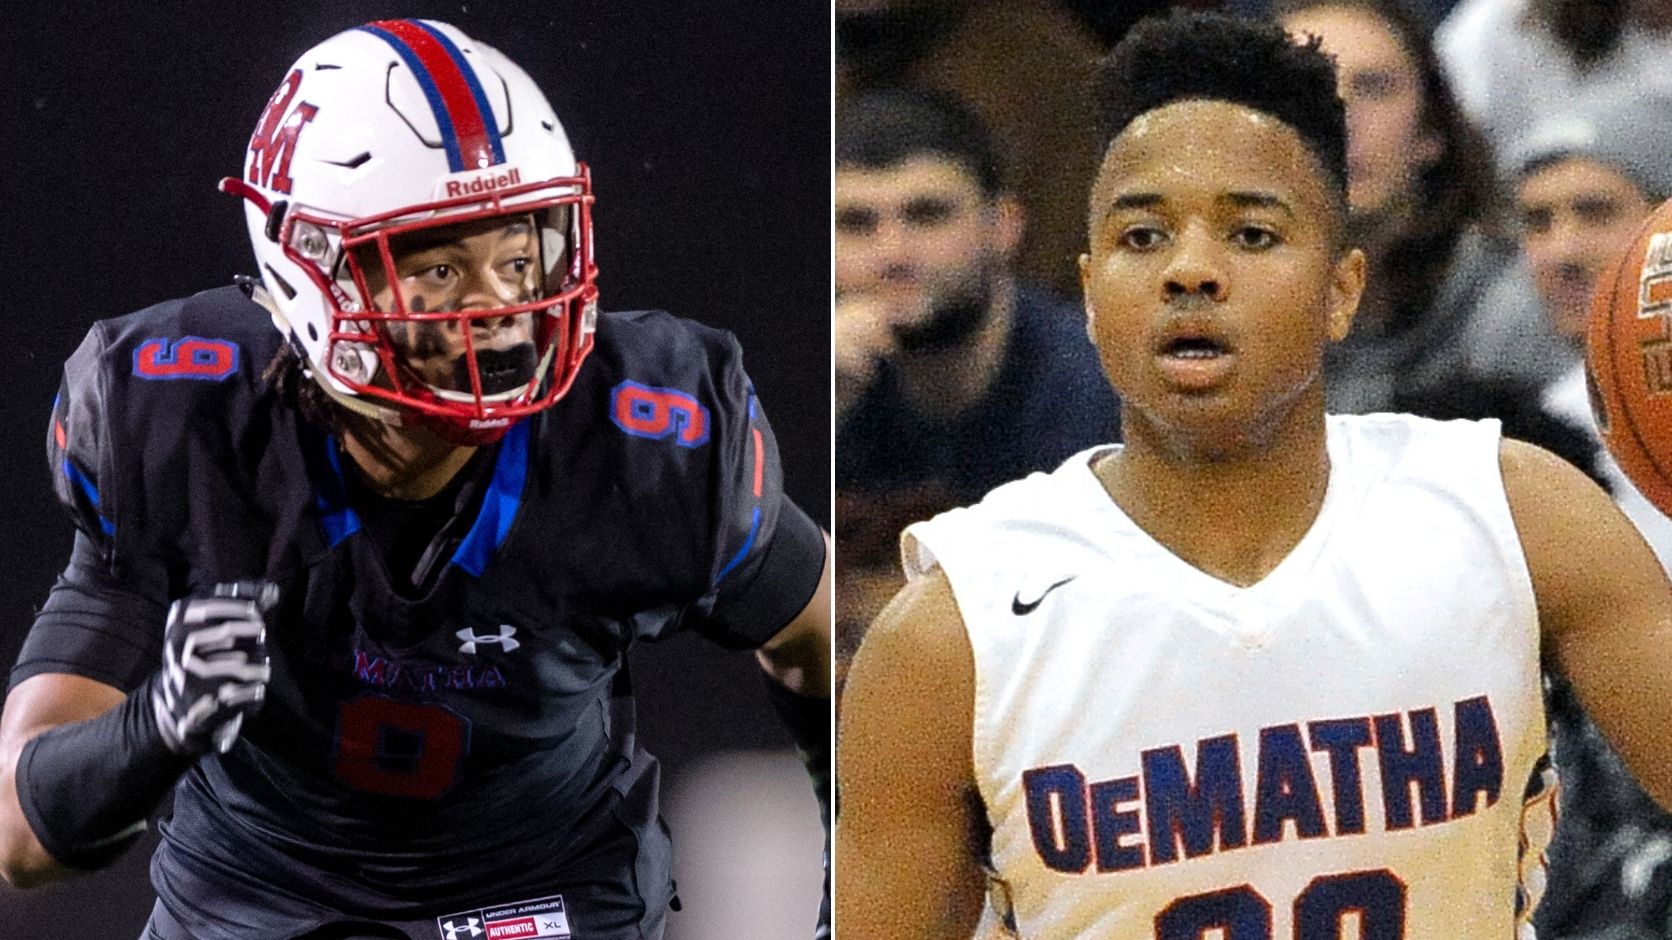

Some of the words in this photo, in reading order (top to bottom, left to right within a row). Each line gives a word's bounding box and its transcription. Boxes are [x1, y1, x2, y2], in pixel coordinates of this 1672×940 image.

[486, 908, 516, 918] UNDER
[518, 902, 560, 913] ARMOUR
[490, 922, 534, 937] AUTHENTIC
[543, 921, 562, 930] XL
